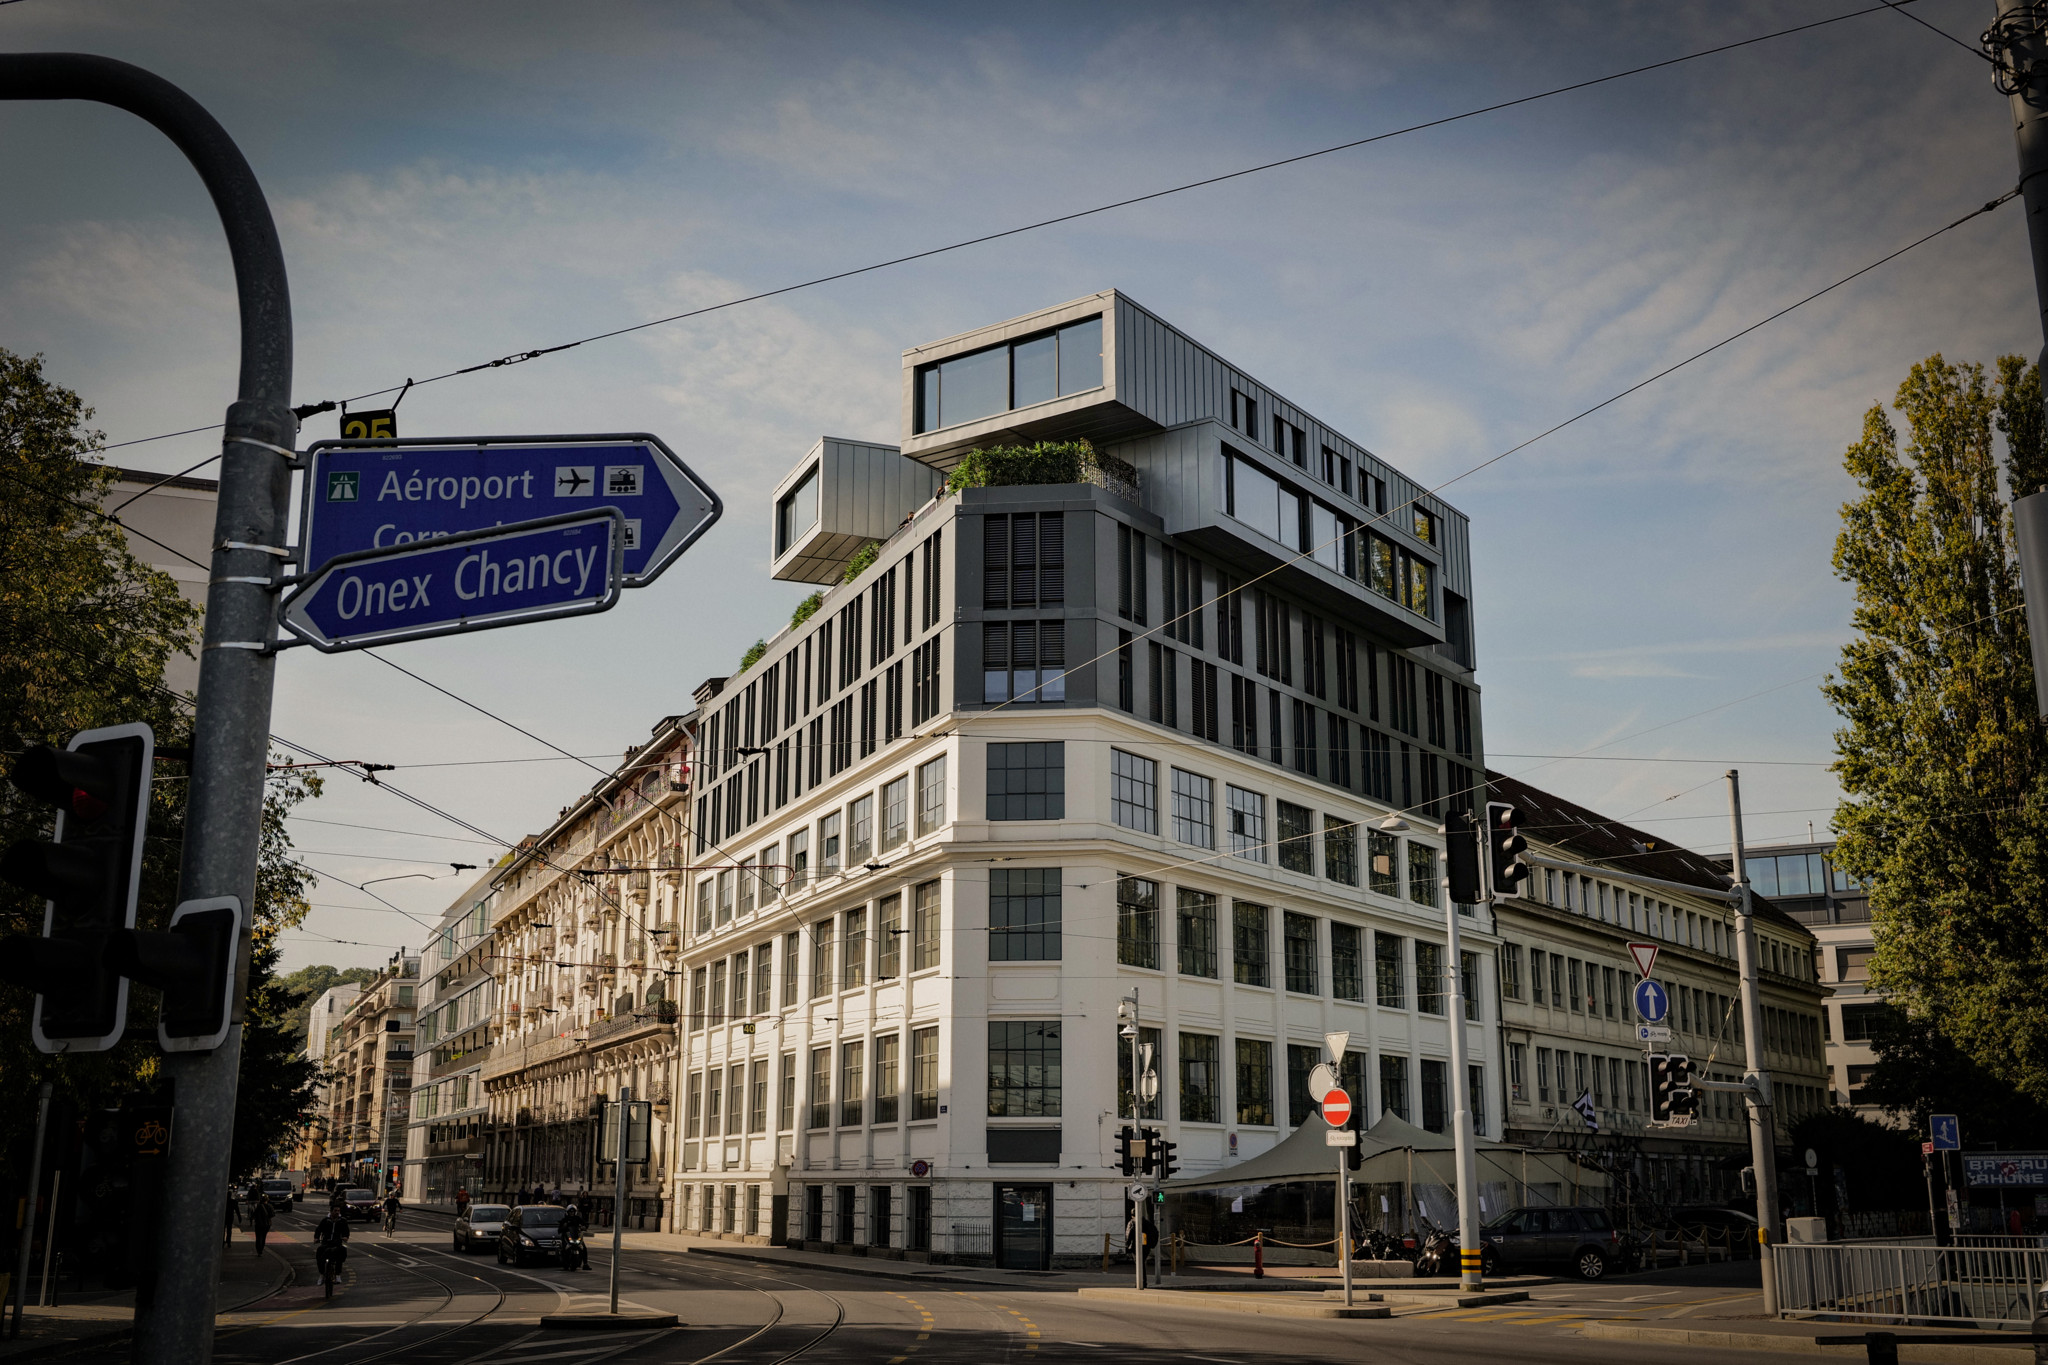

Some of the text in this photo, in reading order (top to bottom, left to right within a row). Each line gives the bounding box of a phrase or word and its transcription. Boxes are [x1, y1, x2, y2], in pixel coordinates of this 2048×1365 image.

[377, 469, 534, 509] Aéroport
[337, 546, 598, 620] Onex Chancy
[743, 1024, 755, 1034] 40
[1672, 1117, 1689, 1125] TAXI
